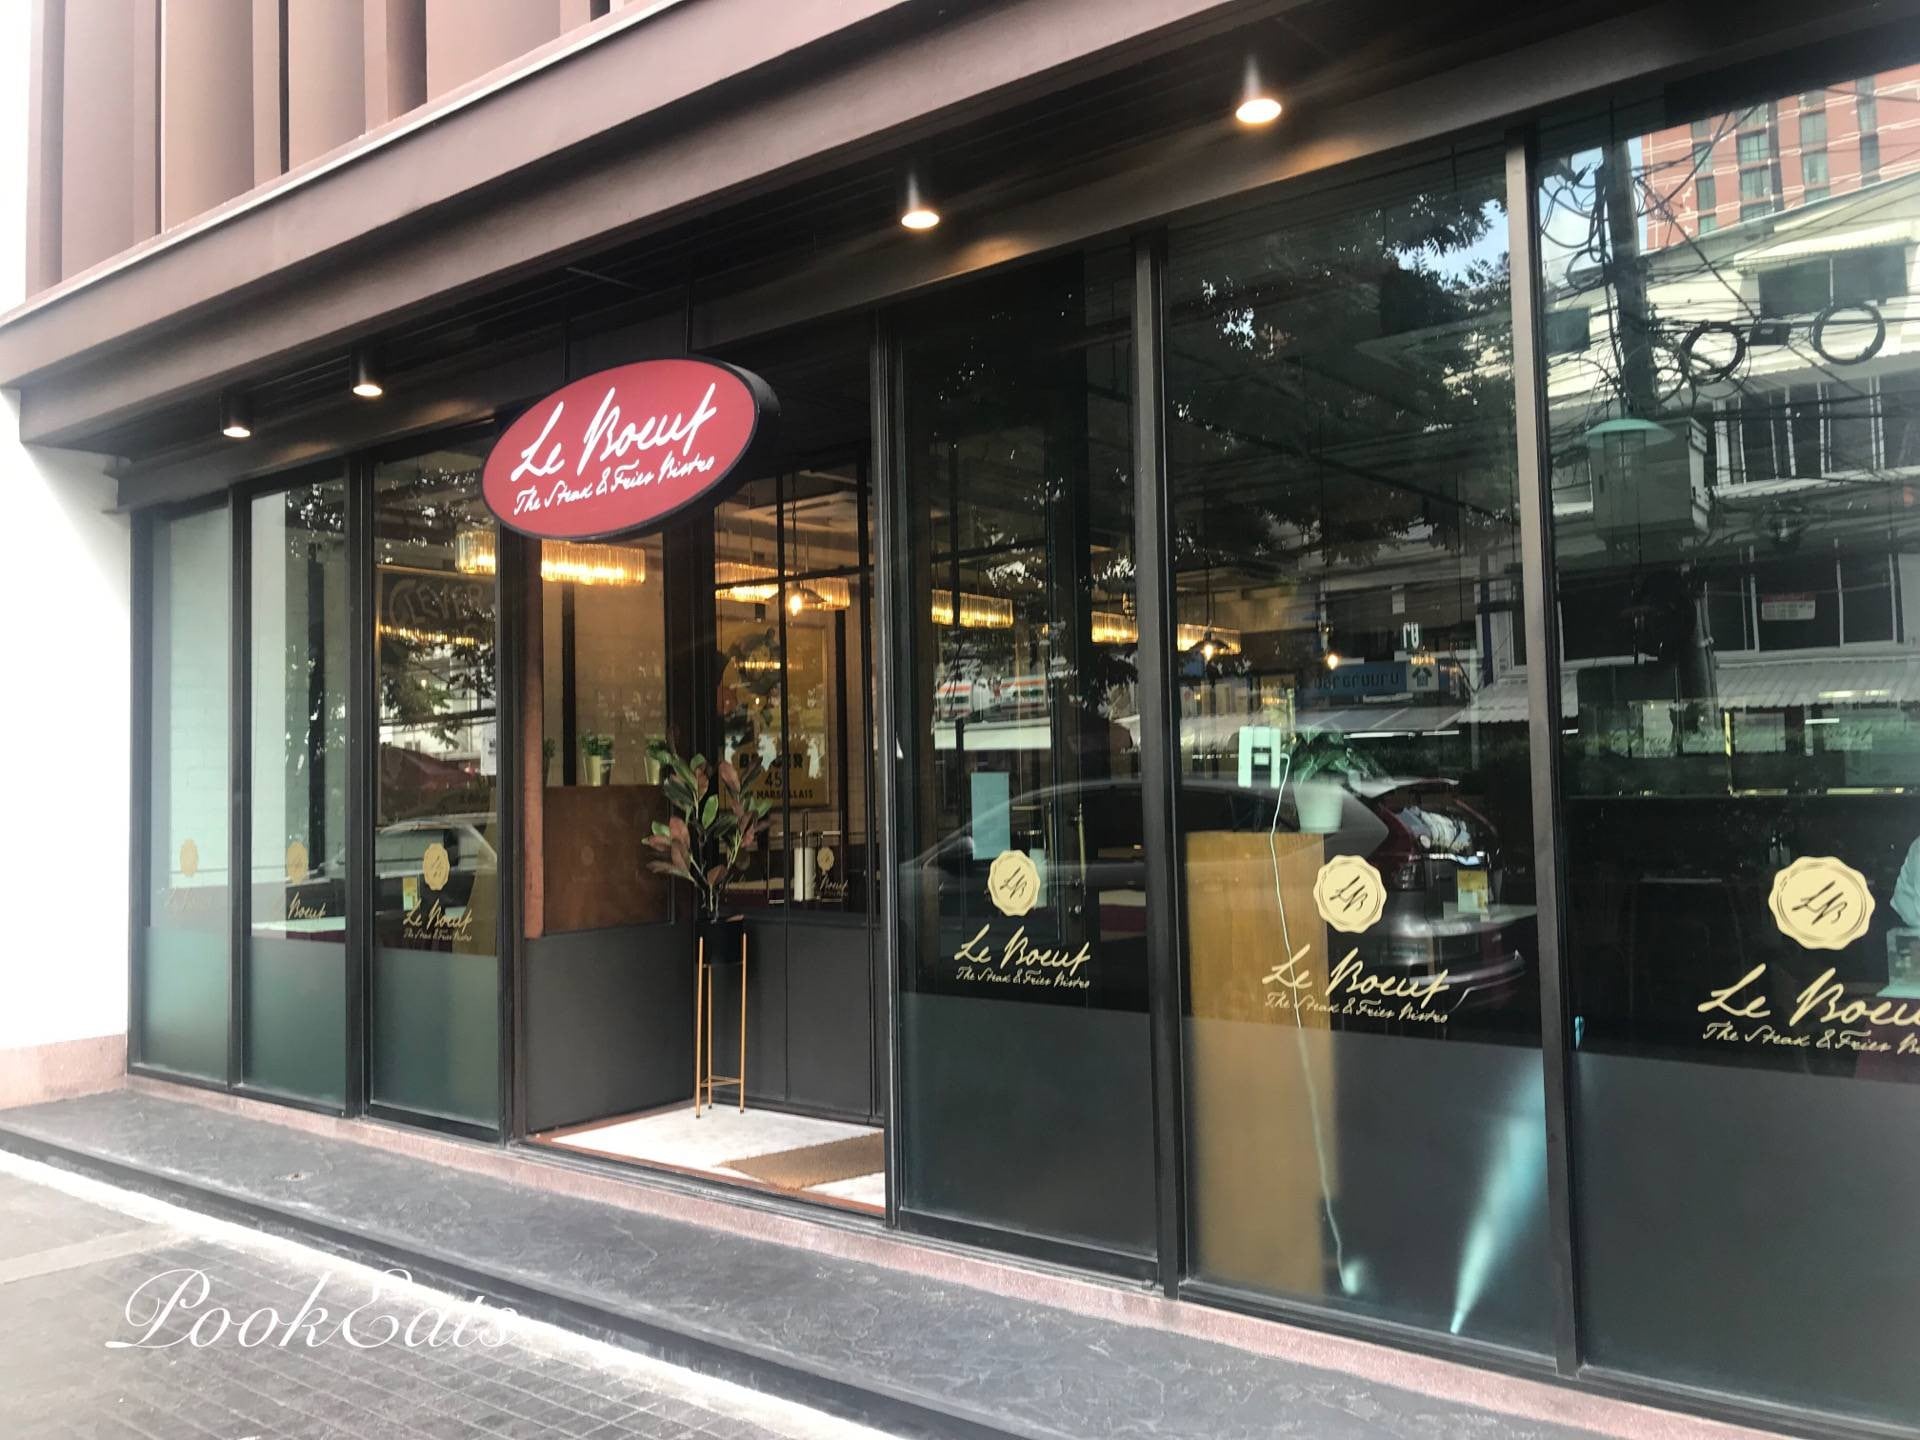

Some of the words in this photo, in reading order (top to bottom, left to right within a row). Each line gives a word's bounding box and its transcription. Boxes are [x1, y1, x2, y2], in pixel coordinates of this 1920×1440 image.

[510, 400, 566, 482] Le
[576, 382, 718, 476] Boeuf
[513, 485, 541, 516] The
[595, 467, 611, 496] &
[610, 459, 655, 493] Fries
[657, 450, 715, 485] Bistro
[954, 923, 991, 963] Le
[1000, 924, 1091, 977] Boeuf
[955, 965, 976, 981] The
[1012, 968, 1021, 985] &
[1261, 943, 1313, 990] Le
[1325, 947, 1450, 1010] Boeuf
[1264, 990, 1290, 1009] The
[1342, 997, 1355, 1015] &
[1697, 962, 1771, 1018] Le
[1788, 967, 1920, 1027] Boeu
[1702, 1020, 1739, 1042] The
[1815, 1028, 1835, 1050] &
